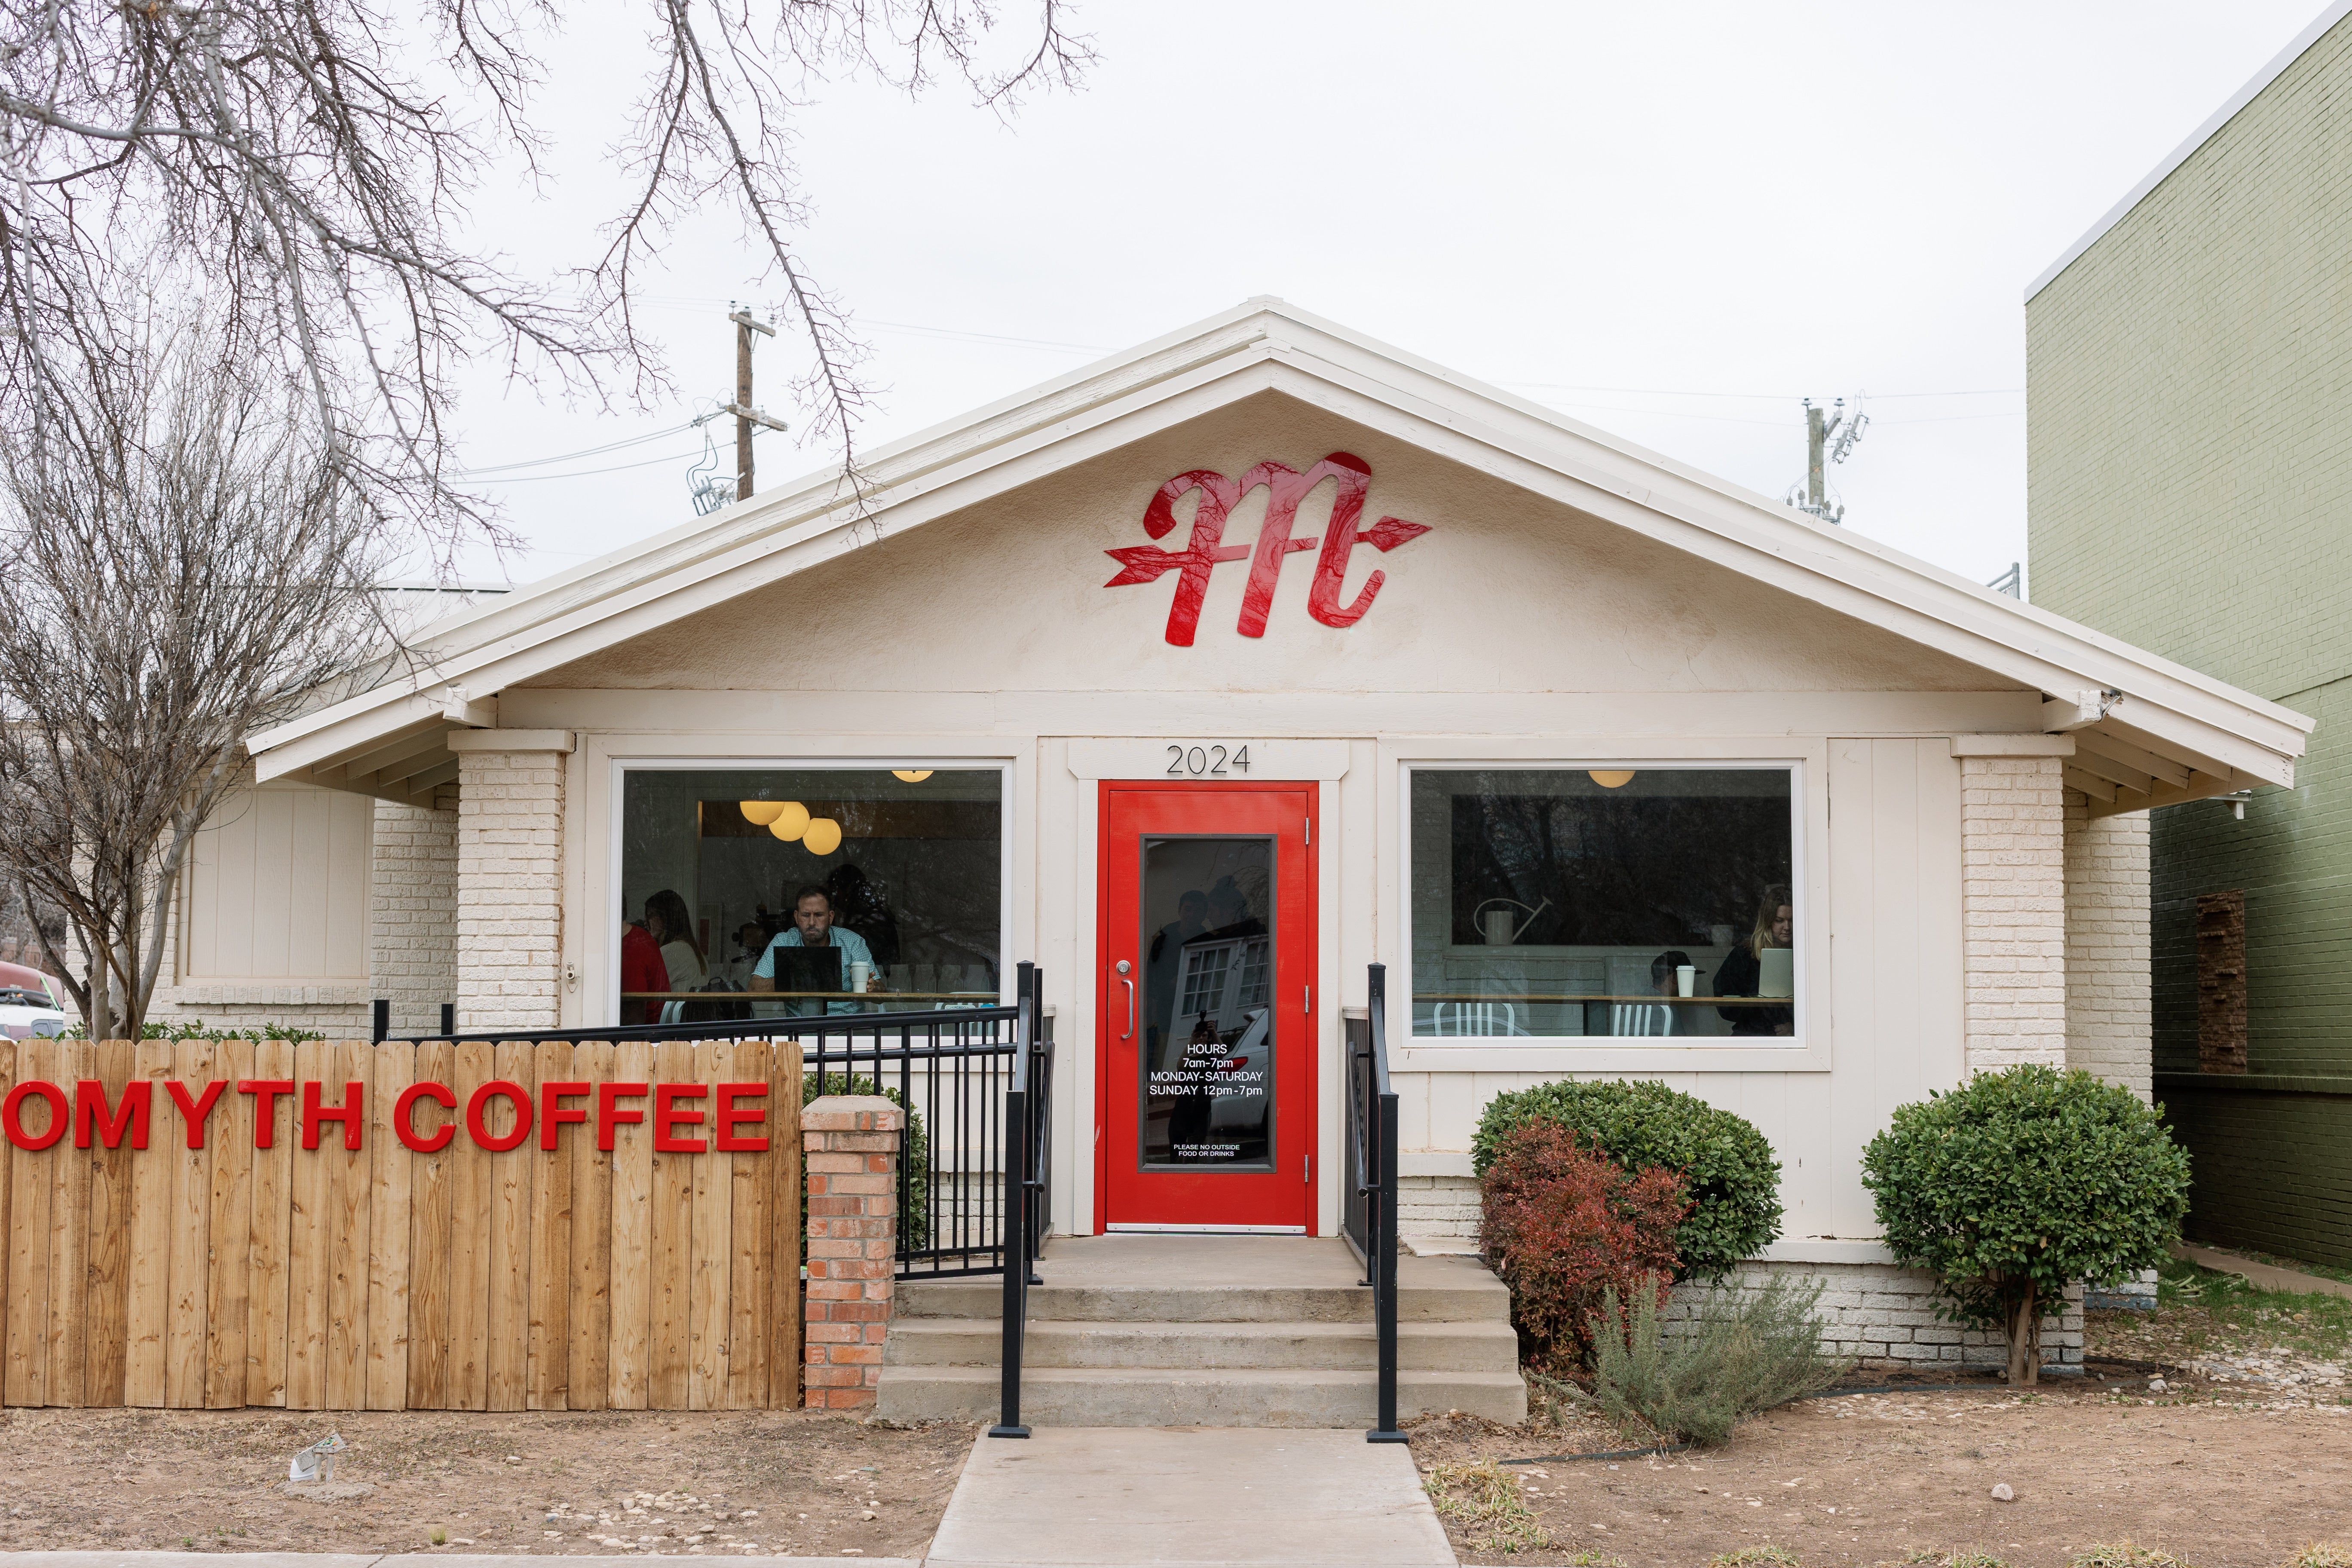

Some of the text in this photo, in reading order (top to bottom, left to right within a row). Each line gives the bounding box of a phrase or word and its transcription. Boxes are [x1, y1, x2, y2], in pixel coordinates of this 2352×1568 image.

[1167, 744, 1251, 775] 2024
[1188, 1044, 1227, 1054] HOURS
[1183, 1058, 1233, 1069] 7am-7pm
[1149, 1085, 1198, 1095] SUNDAY
[2, 1078, 774, 1155] OMYTH COFFEE
